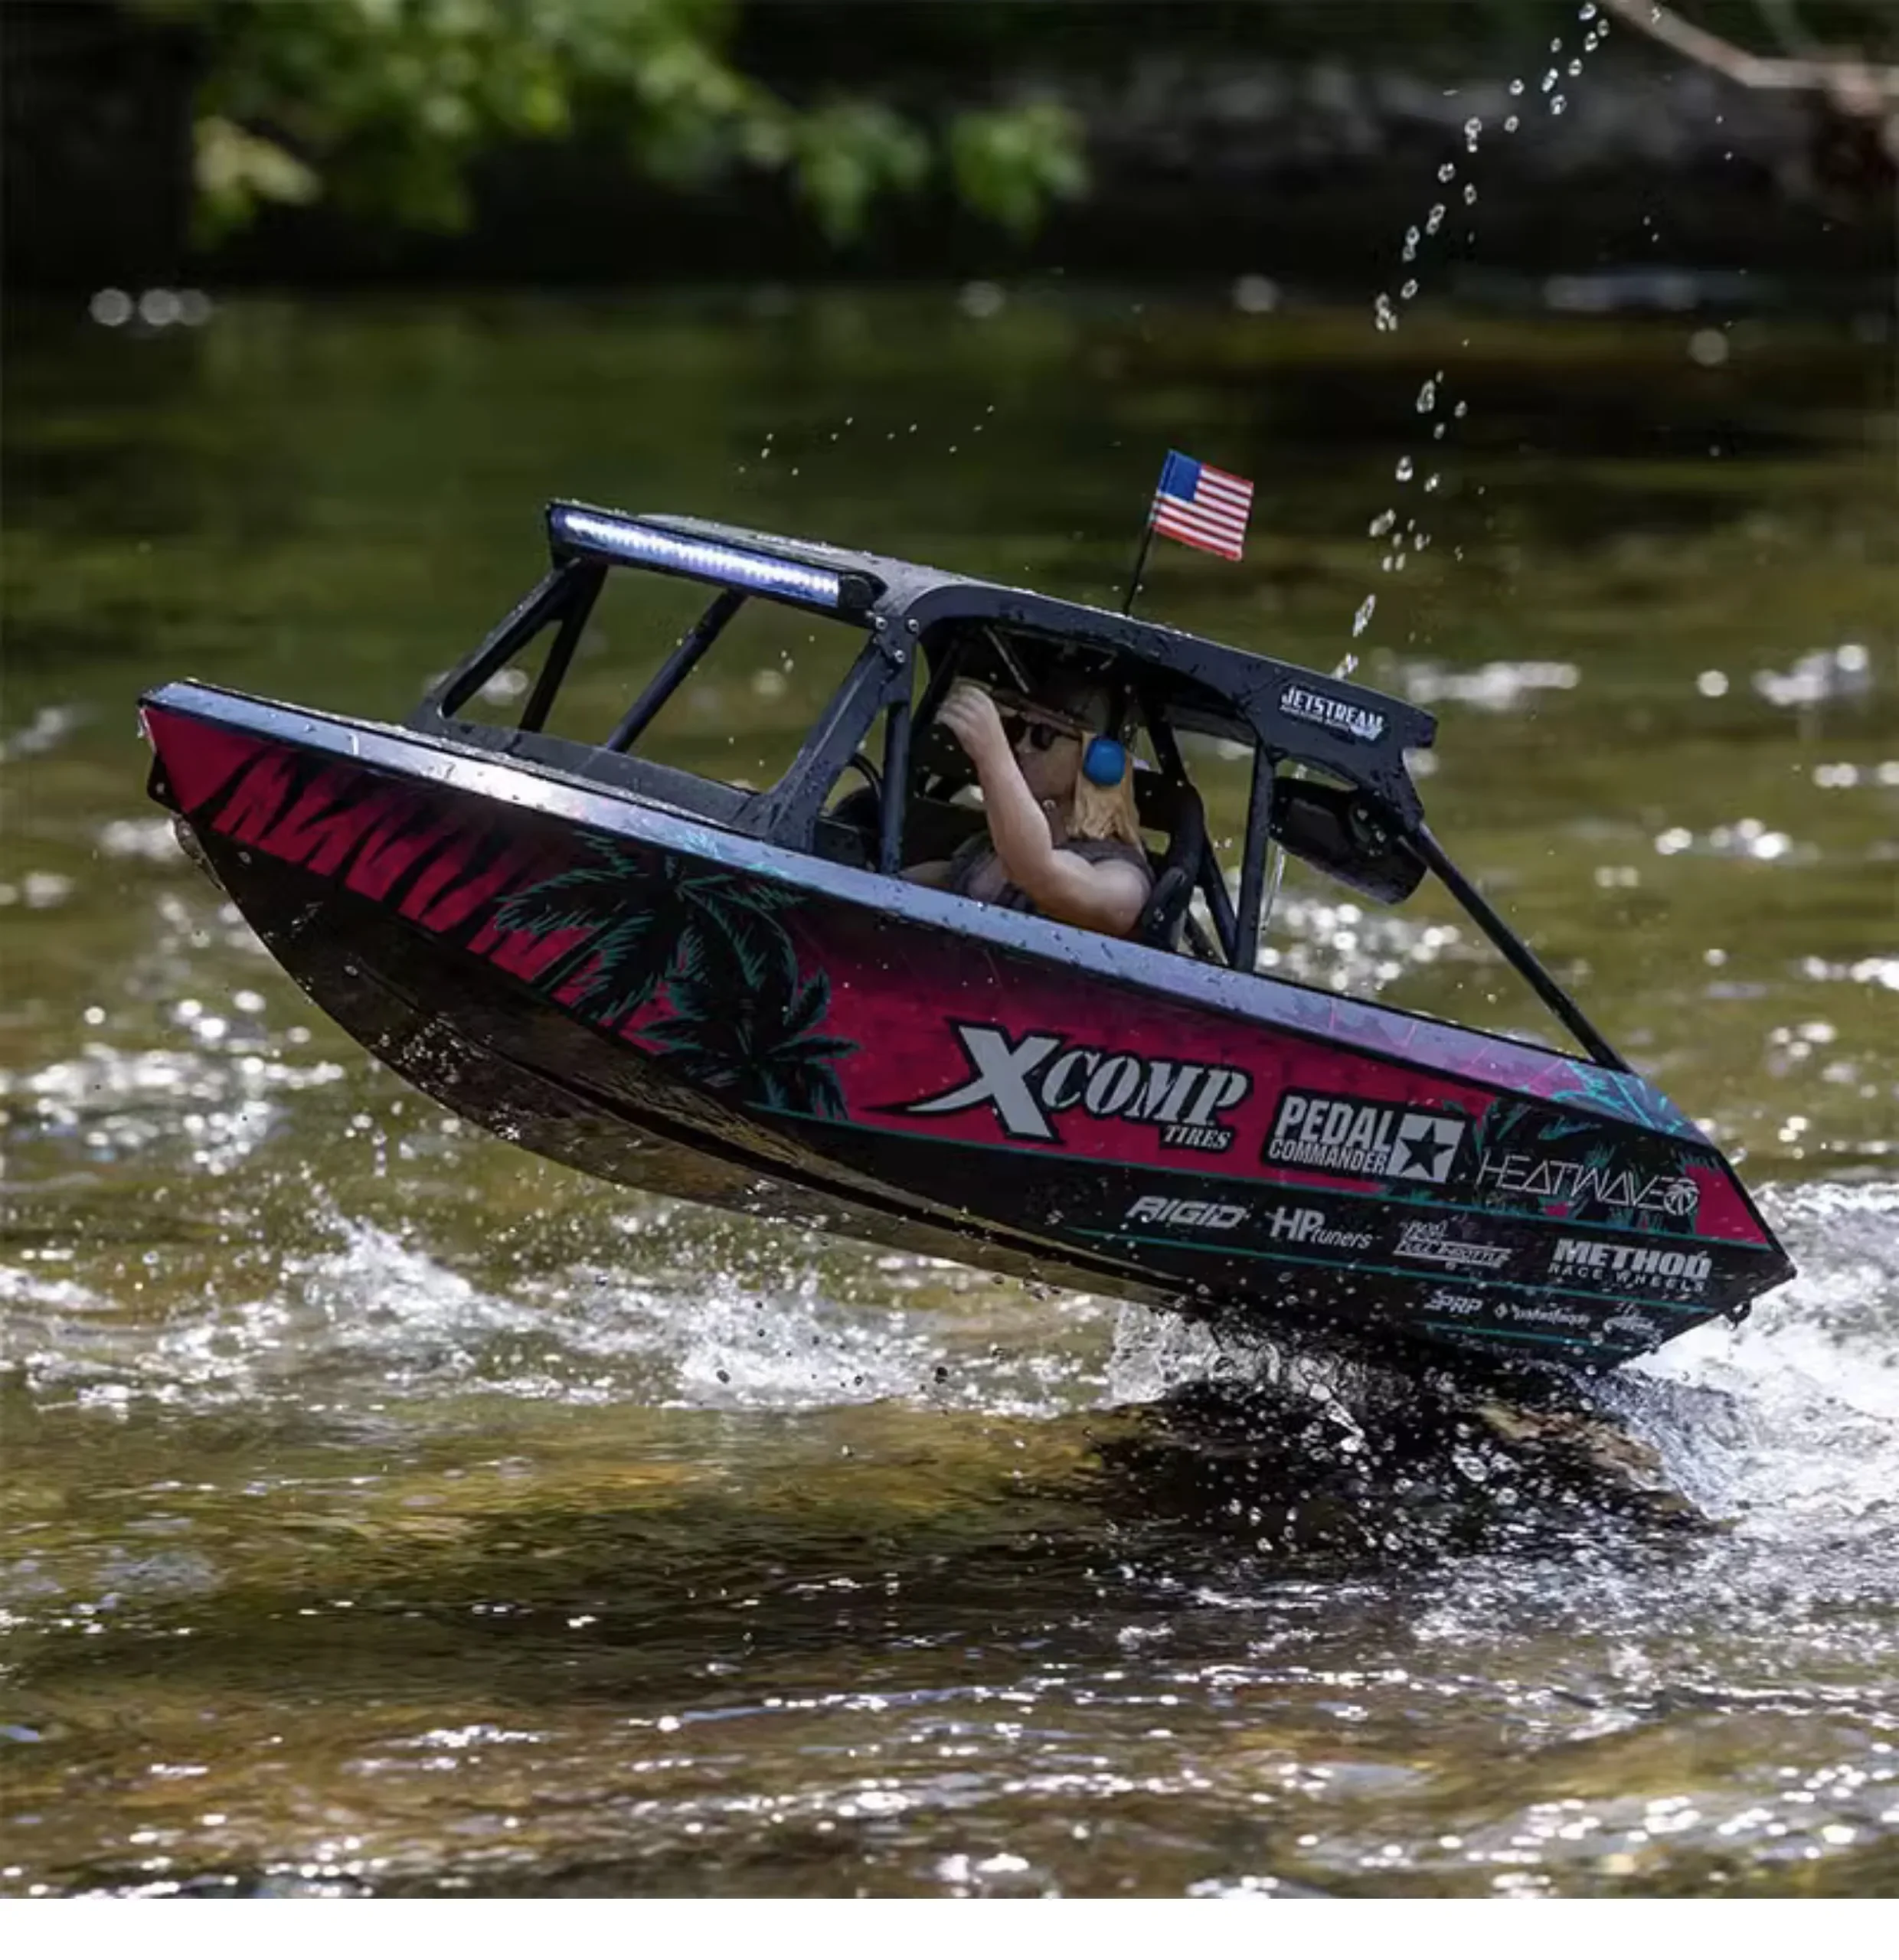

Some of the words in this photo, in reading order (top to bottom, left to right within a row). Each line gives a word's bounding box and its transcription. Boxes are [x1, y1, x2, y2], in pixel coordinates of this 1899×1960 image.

[1280, 685, 1384, 731] JETSTREAM
[1162, 1125, 1231, 1149] TIRES
[1273, 1094, 1394, 1152] PEDAL
[1268, 1138, 1392, 1175] COMMANDER
[1476, 1150, 1675, 1210] HEATWAVE
[1126, 1196, 1247, 1229] RIGID
[1548, 1263, 1603, 1280] RACE
[1616, 1269, 1705, 1292] WHEELS
[1552, 1238, 1712, 1280] METHOD
